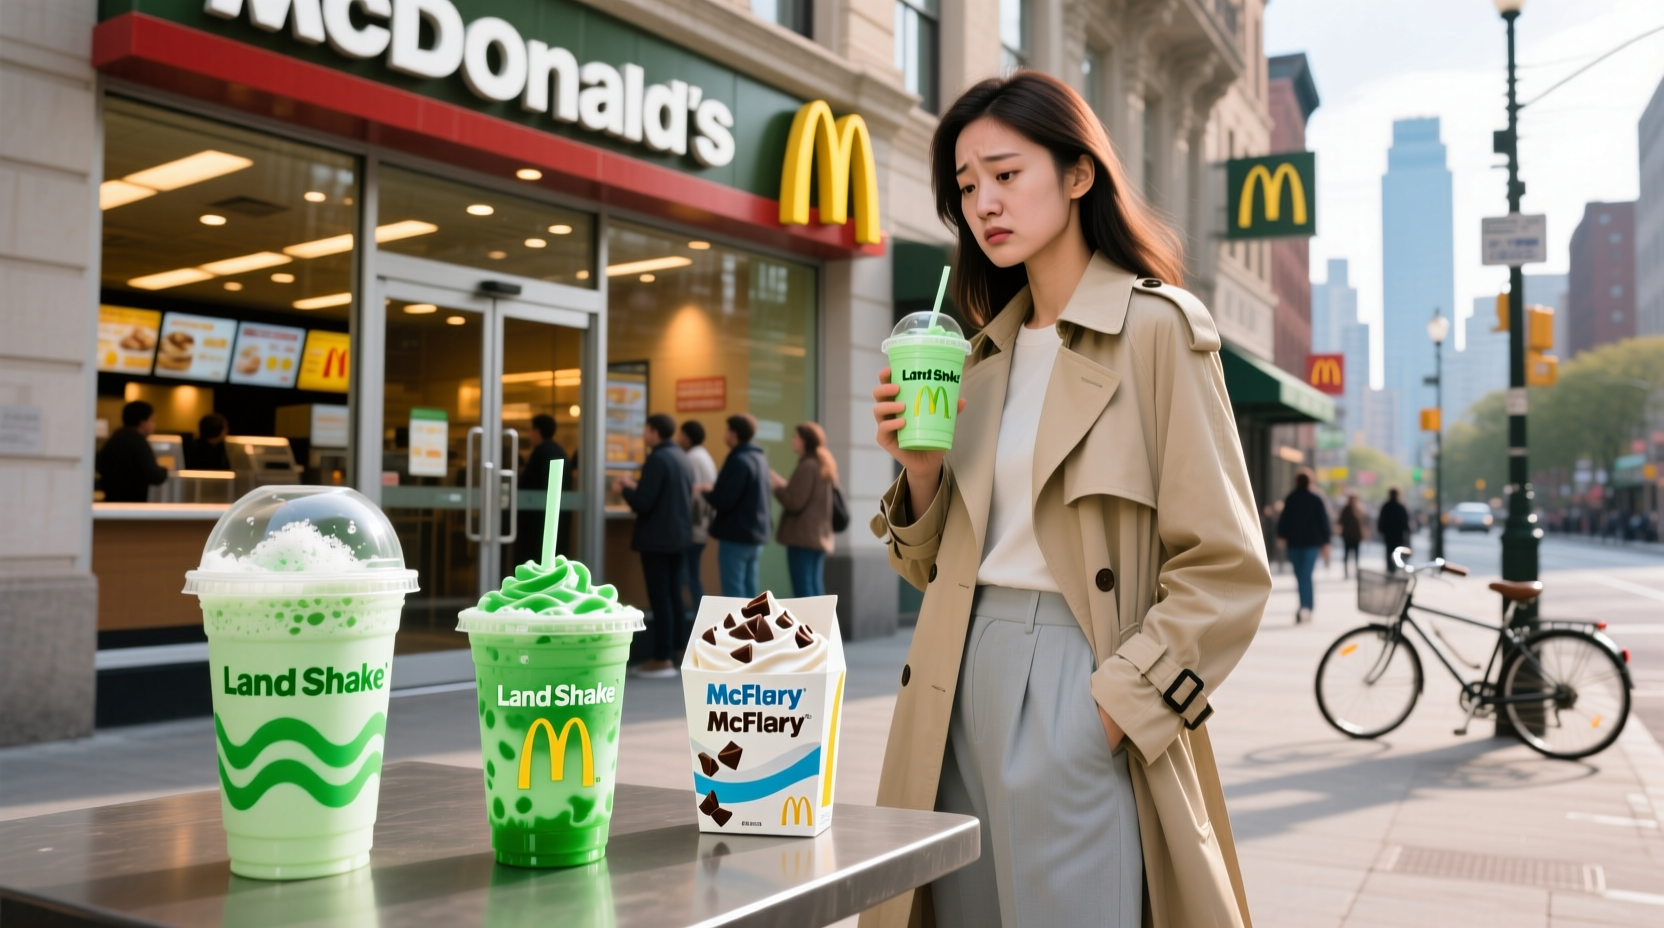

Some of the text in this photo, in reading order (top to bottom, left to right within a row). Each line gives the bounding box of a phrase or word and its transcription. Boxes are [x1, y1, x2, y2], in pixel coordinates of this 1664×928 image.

[779, 99, 881, 244] M
[1237, 162, 1307, 229] M
[223, 662, 385, 697] Land Shake
[497, 681, 616, 707] Land Shake
[706, 683, 803, 711] McFlary
[706, 711, 805, 738] McFlary
[517, 717, 595, 790] M
[781, 796, 813, 826] M
